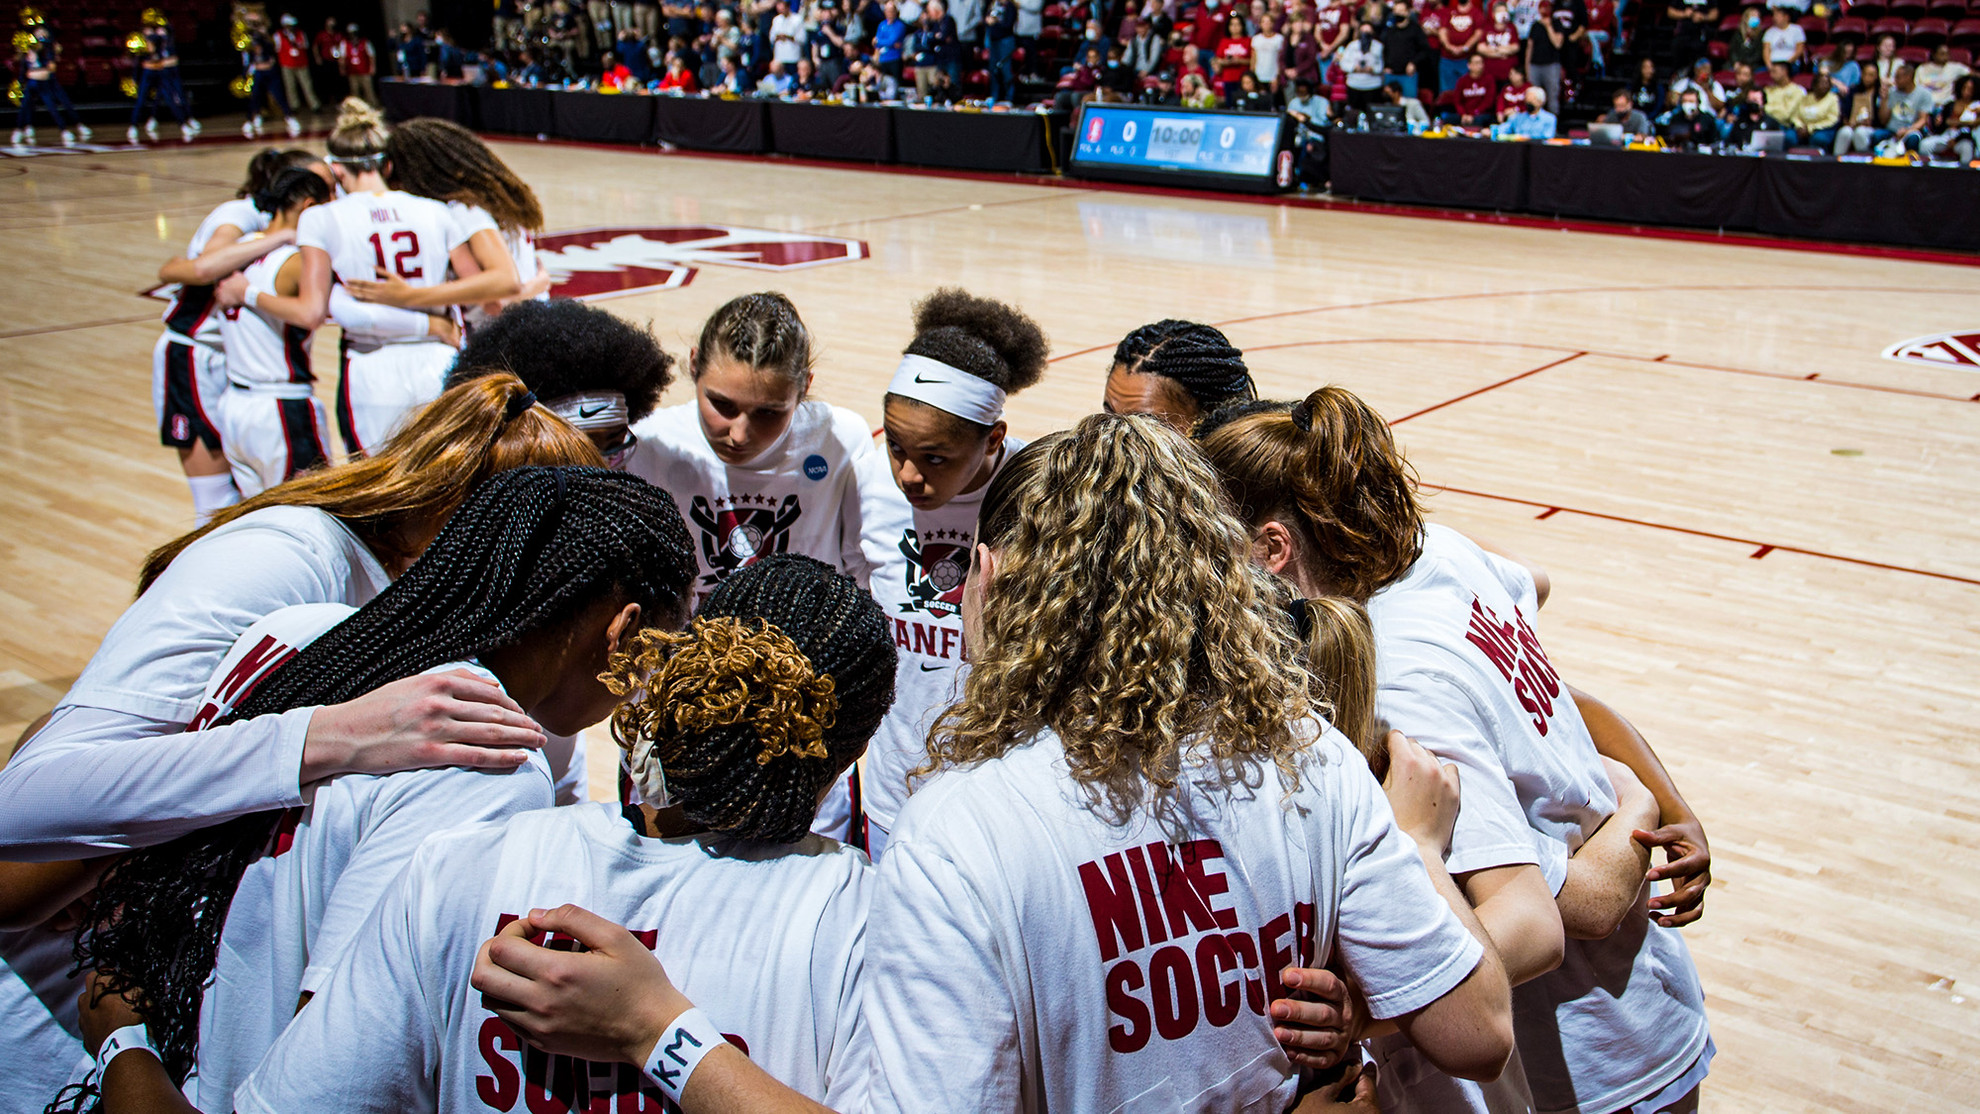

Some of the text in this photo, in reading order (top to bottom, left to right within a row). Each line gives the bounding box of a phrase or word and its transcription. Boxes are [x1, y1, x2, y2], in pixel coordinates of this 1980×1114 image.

[1122, 121, 1137, 142] 0
[1152, 126, 1200, 145] 10:00
[1221, 126, 1236, 149] 0
[369, 231, 423, 279] 12
[923, 600, 956, 613] SOCCER
[1077, 839, 1239, 963] NIKE
[651, 1027, 703, 1090] KM
